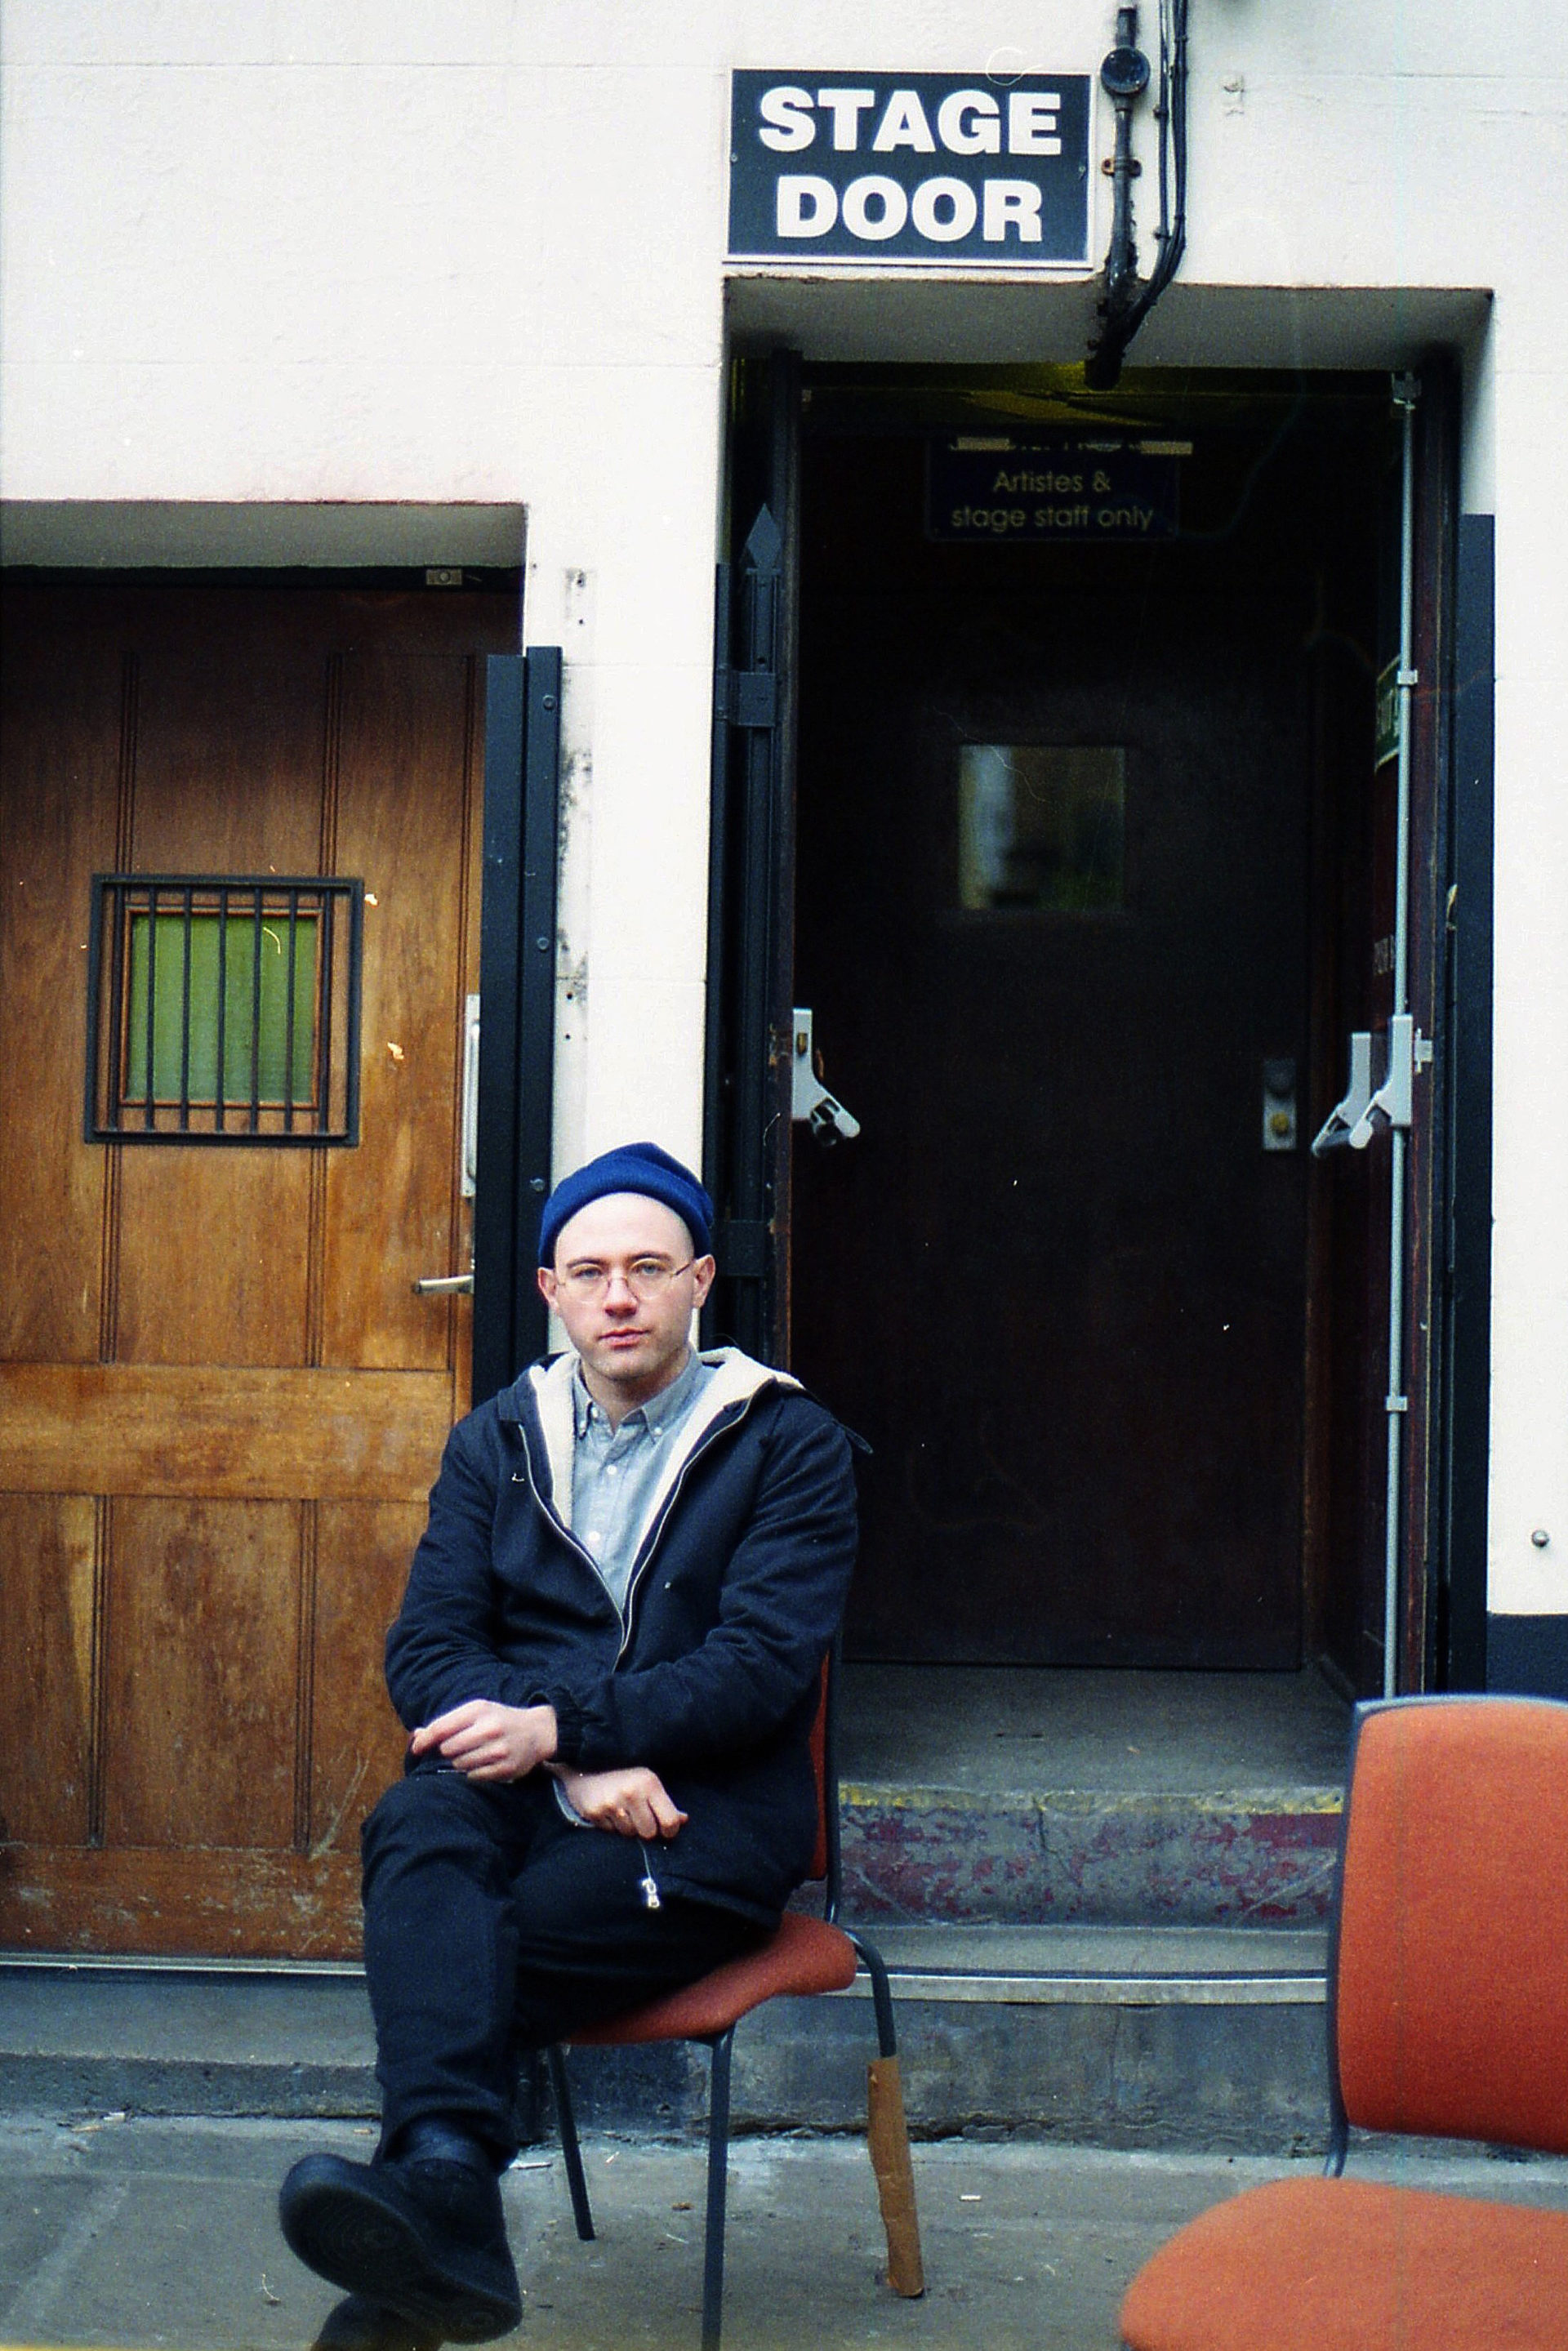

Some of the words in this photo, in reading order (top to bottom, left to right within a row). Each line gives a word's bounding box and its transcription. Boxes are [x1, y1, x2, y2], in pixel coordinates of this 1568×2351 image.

[759, 87, 1062, 155] STAGE
[776, 175, 1043, 242] DOOR
[993, 470, 1084, 492] Artistes
[1092, 470, 1111, 492] &
[951, 505, 1027, 532] stage
[1034, 504, 1092, 528] staff
[1098, 505, 1153, 532] only
